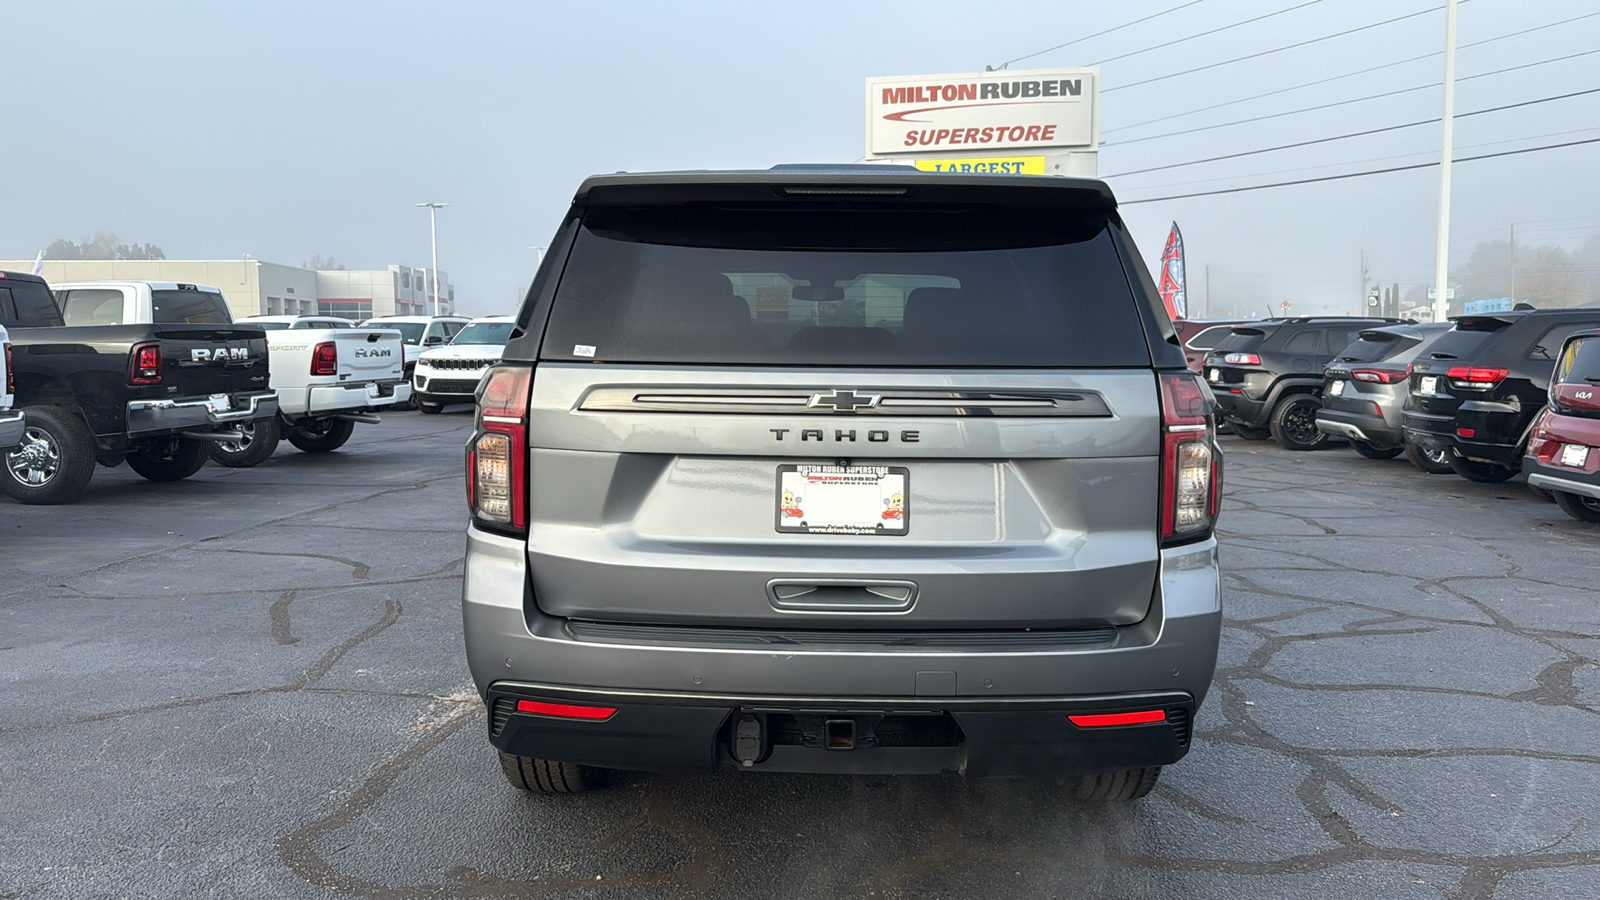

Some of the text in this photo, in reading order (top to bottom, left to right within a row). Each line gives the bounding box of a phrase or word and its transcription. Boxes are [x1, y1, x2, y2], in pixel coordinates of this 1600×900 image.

[882, 79, 1082, 105] MILTON RUBEN
[904, 125, 1057, 146] SUPERSTORE
[935, 162, 1025, 174] LARGEST
[191, 347, 249, 362] RAM
[354, 348, 391, 358] RAM
[769, 428, 920, 442] TAHOE
[796, 465, 889, 474] MILTON RUBEN SUPERSTORE
